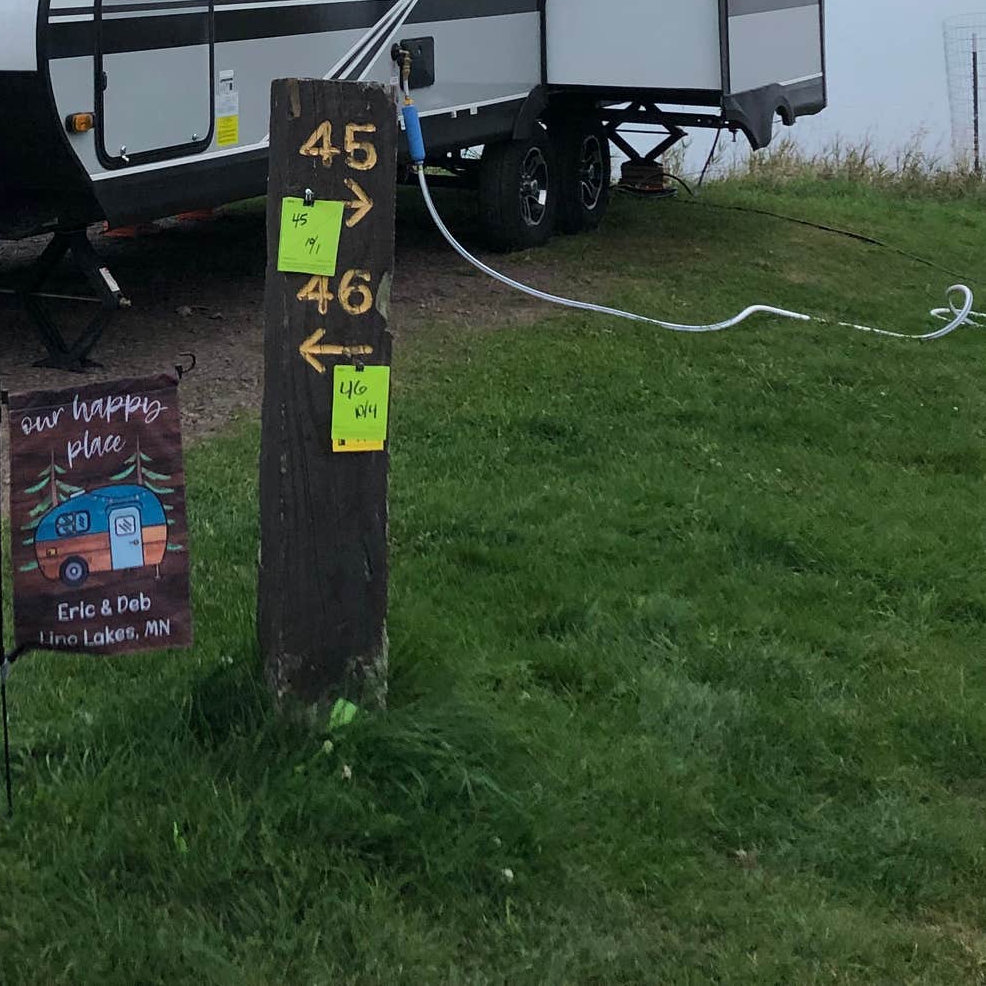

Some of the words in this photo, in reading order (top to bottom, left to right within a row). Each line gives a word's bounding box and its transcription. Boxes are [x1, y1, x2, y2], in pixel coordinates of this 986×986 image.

[299, 119, 378, 171] 45
[292, 213, 308, 229] 45
[296, 269, 373, 315] 46
[339, 380, 367, 399] 46
[21, 405, 64, 435] our
[72, 393, 168, 424] happy
[67, 430, 126, 468] place
[58, 600, 95, 621] Eric
[101, 599, 113, 616] &
[117, 592, 151, 614] Deb
[145, 618, 170, 637] MN
